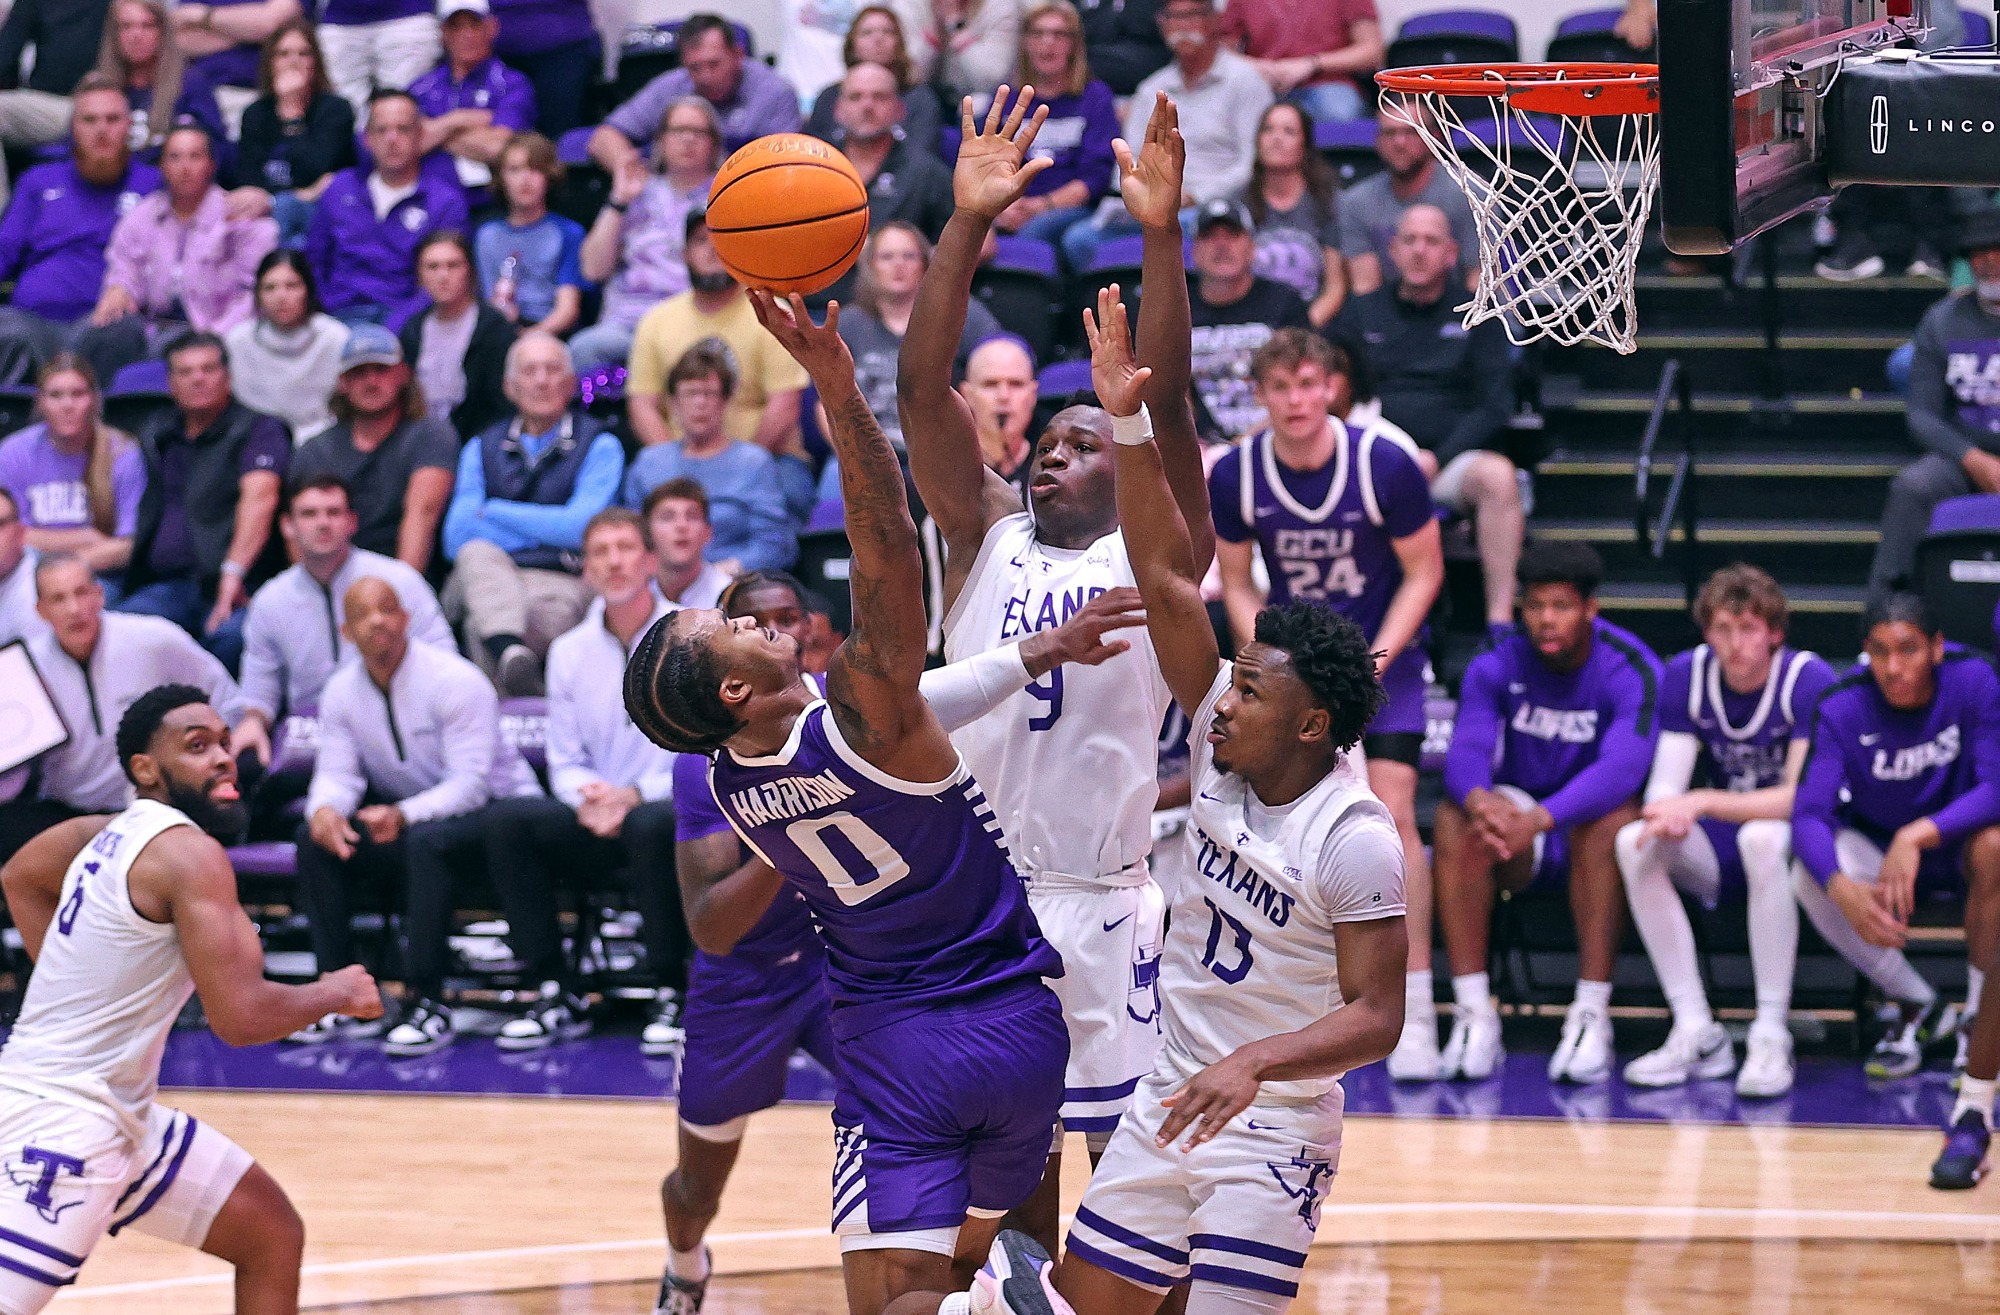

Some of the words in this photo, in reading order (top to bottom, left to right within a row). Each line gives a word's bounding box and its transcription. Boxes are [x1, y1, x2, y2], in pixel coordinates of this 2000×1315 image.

[1275, 528, 1355, 558] GCU
[1281, 556, 1367, 599] 24
[1001, 586, 1107, 640] EXAN
[1024, 664, 1064, 732] 9
[730, 767, 857, 829] HARRISON
[785, 810, 911, 907] 0
[1197, 827, 1296, 928] TEXANS
[1201, 895, 1255, 985] 13
